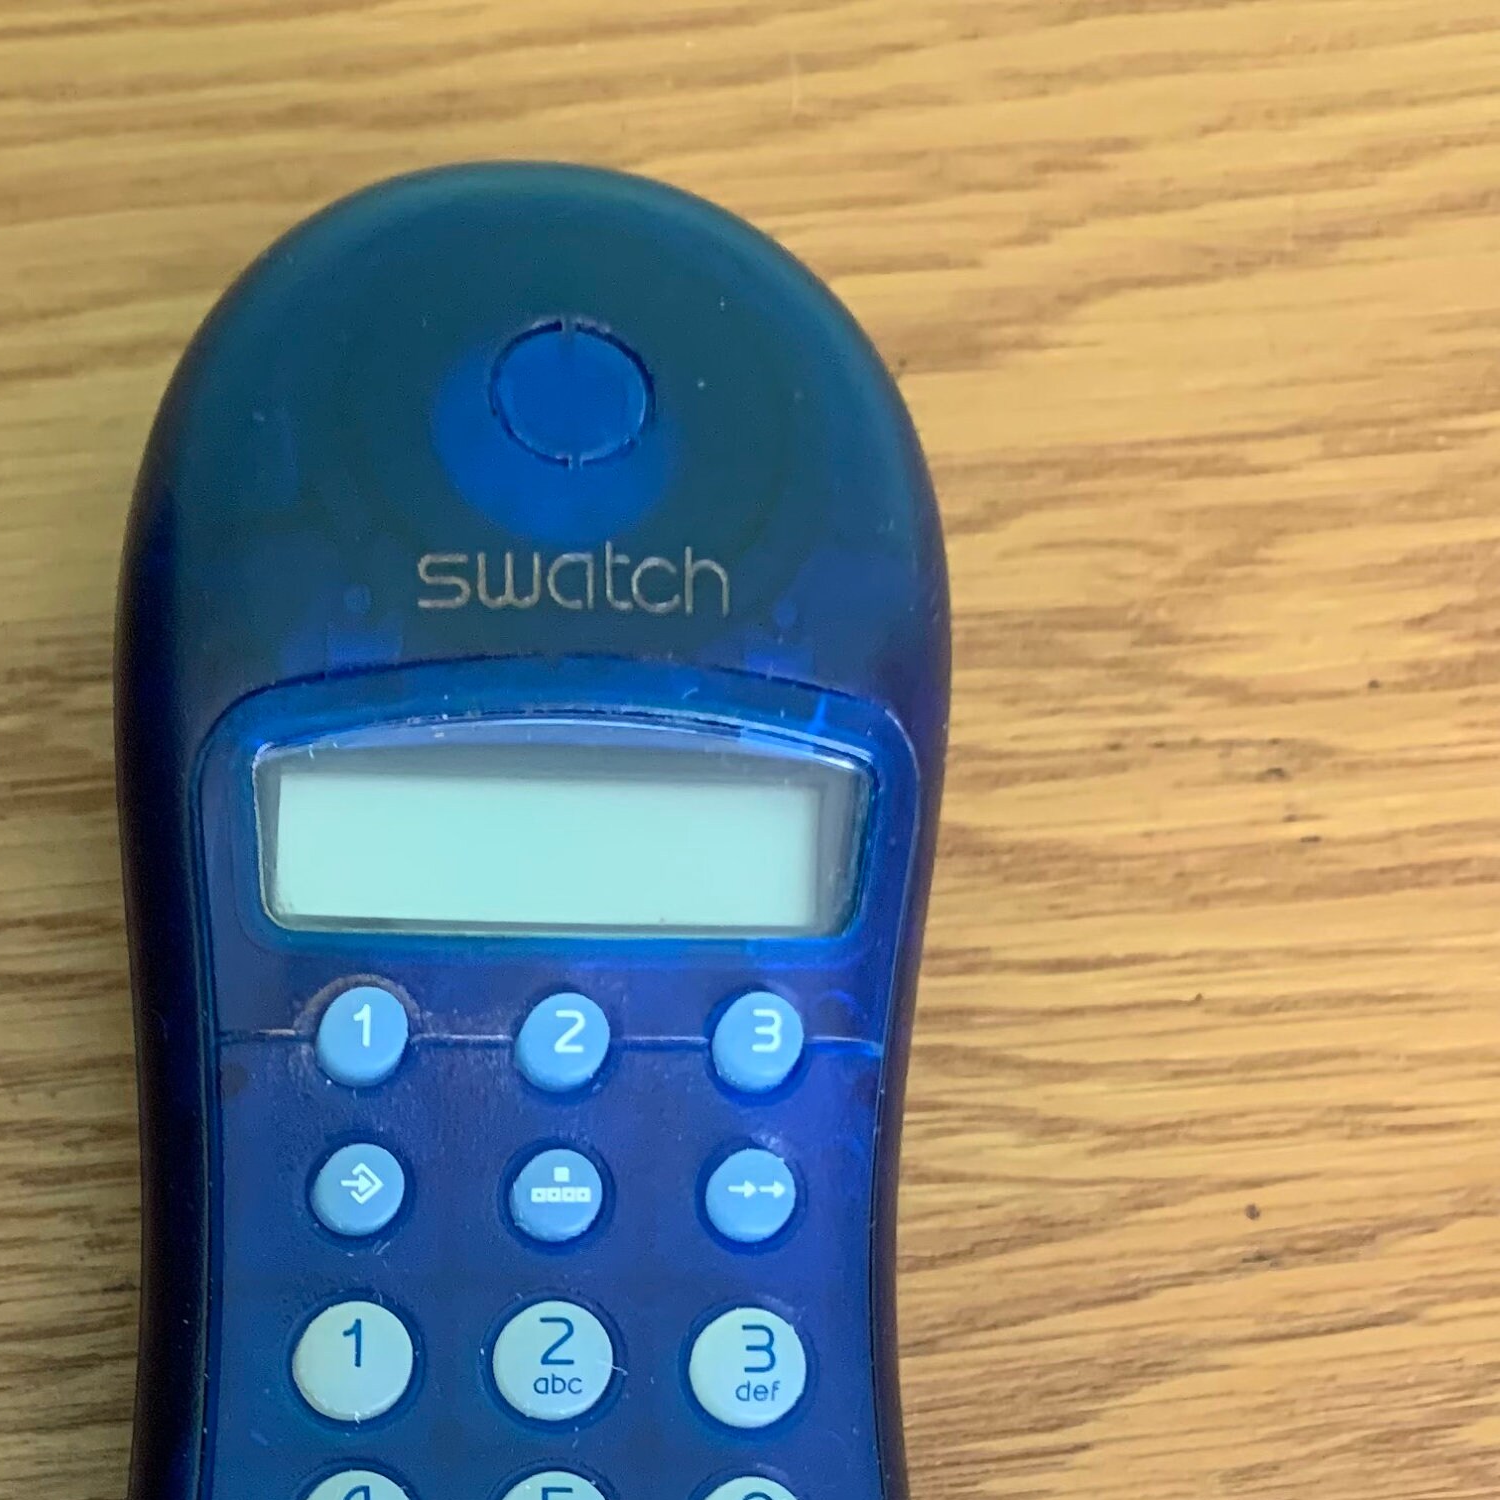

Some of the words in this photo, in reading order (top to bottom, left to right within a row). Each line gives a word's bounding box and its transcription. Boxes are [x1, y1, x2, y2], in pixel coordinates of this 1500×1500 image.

[417, 541, 730, 617] swatch
[352, 1004, 371, 1047] 1
[555, 1010, 585, 1053] 2
[753, 1009, 782, 1052] 3
[342, 1318, 364, 1367] 1
[538, 1317, 575, 1366] 2
[742, 1324, 776, 1373] 3
[532, 1371, 583, 1397] abc
[734, 1377, 781, 1403] def
